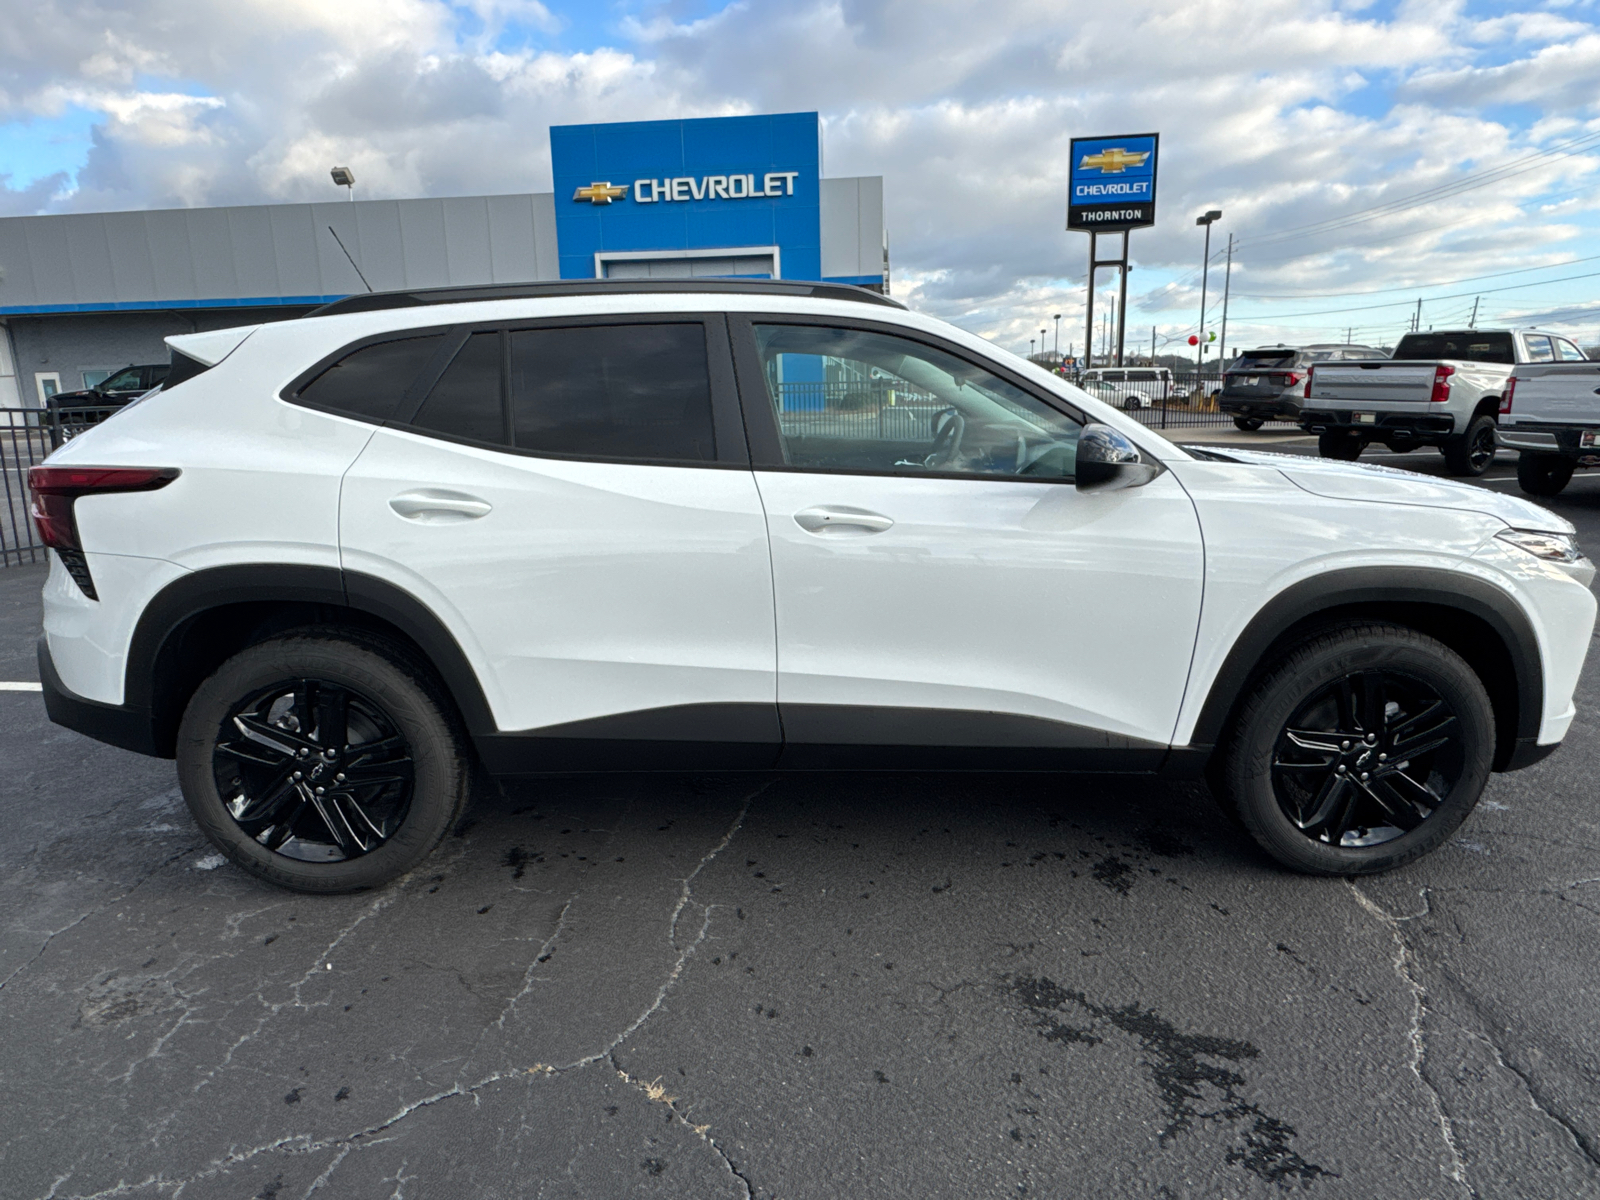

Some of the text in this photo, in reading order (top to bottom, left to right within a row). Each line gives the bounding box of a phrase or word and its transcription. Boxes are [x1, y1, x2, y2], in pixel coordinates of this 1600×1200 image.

[634, 172, 799, 203] CHEVROLET
[1076, 182, 1149, 196] CHEVROLET
[1081, 209, 1142, 221] THORNTON
